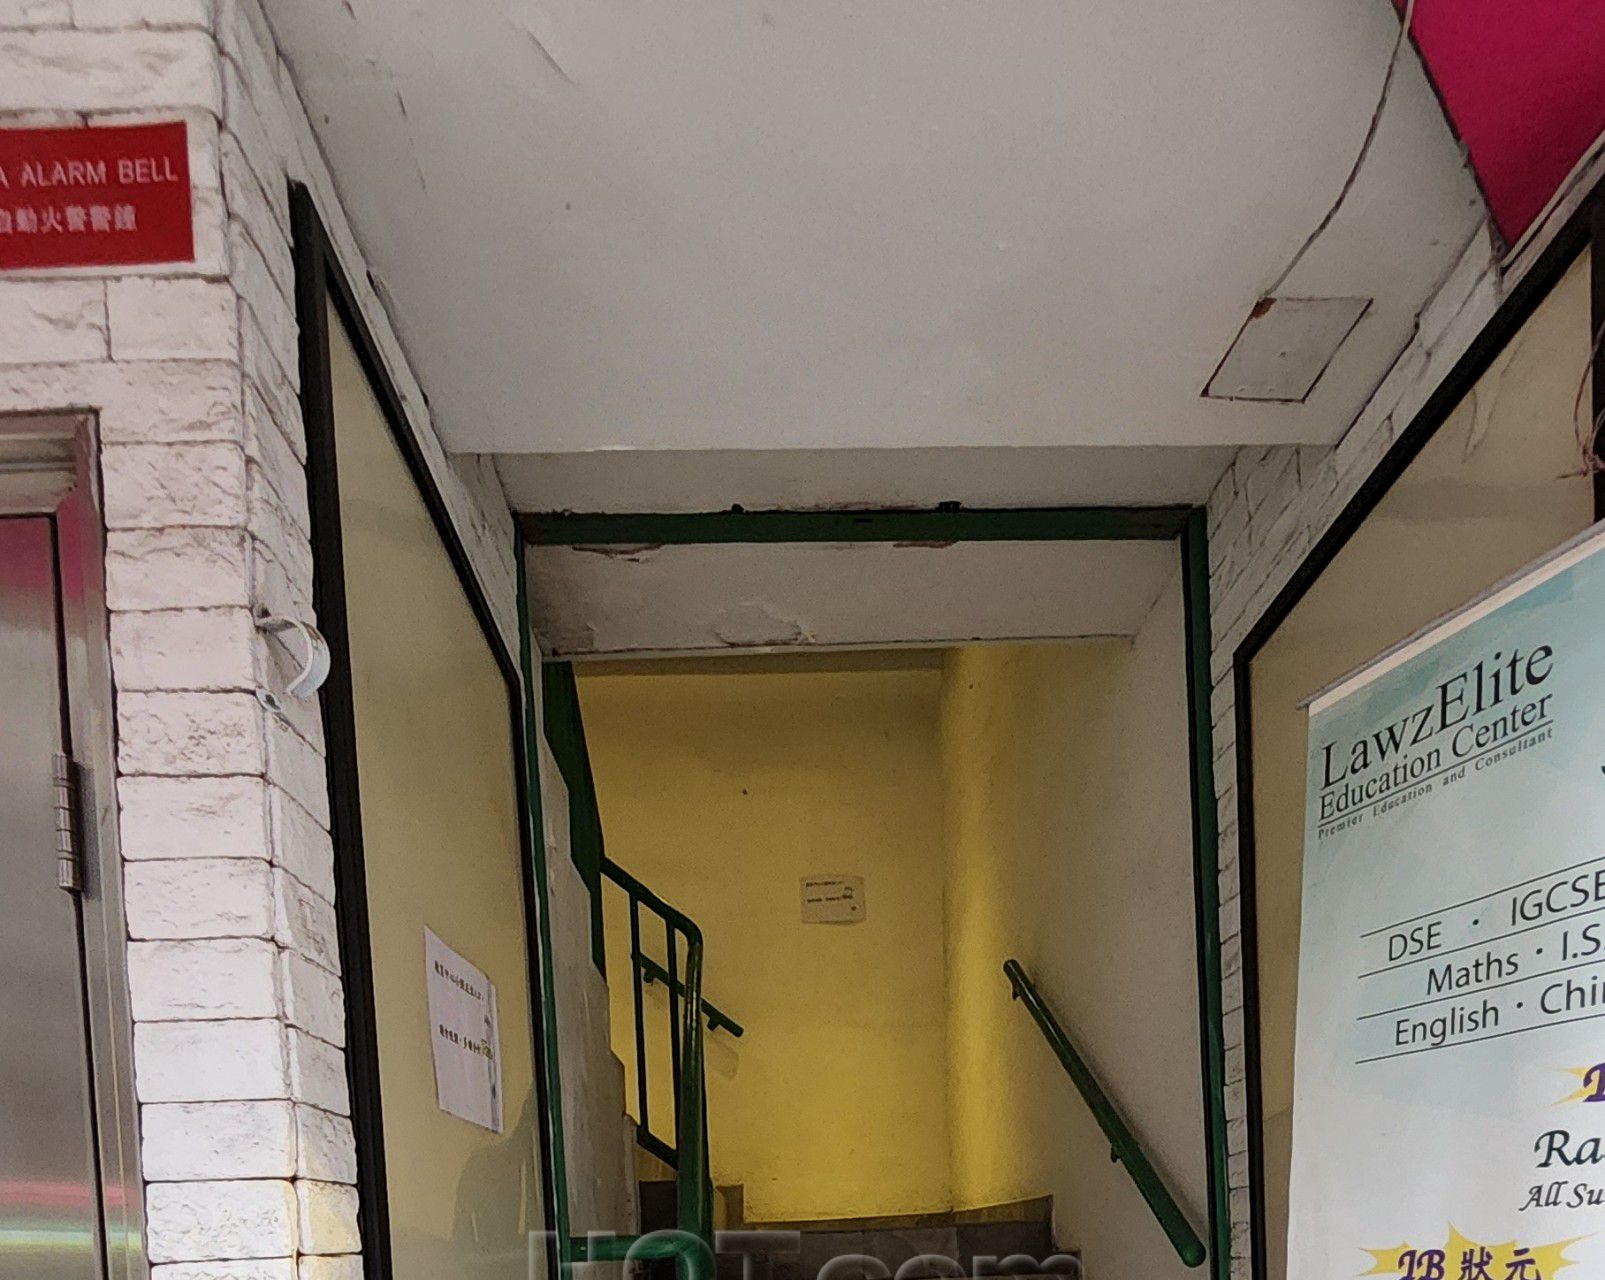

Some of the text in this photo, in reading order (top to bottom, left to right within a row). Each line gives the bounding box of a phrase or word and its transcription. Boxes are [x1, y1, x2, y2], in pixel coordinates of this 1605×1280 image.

[21, 159, 108, 188] ALARM
[117, 155, 179, 184] BELL
[1320, 645, 1554, 791] LawzElite
[1318, 727, 1554, 840] Premier Education and Consultant
[1320, 693, 1553, 822] Education Center
[1388, 921, 1443, 962] DSE
[1427, 923, 1605, 996] Maths I.S
[1396, 975, 1605, 1047] English Chi
[1534, 1130, 1605, 1169] Ra
[1518, 1181, 1569, 1212] All
